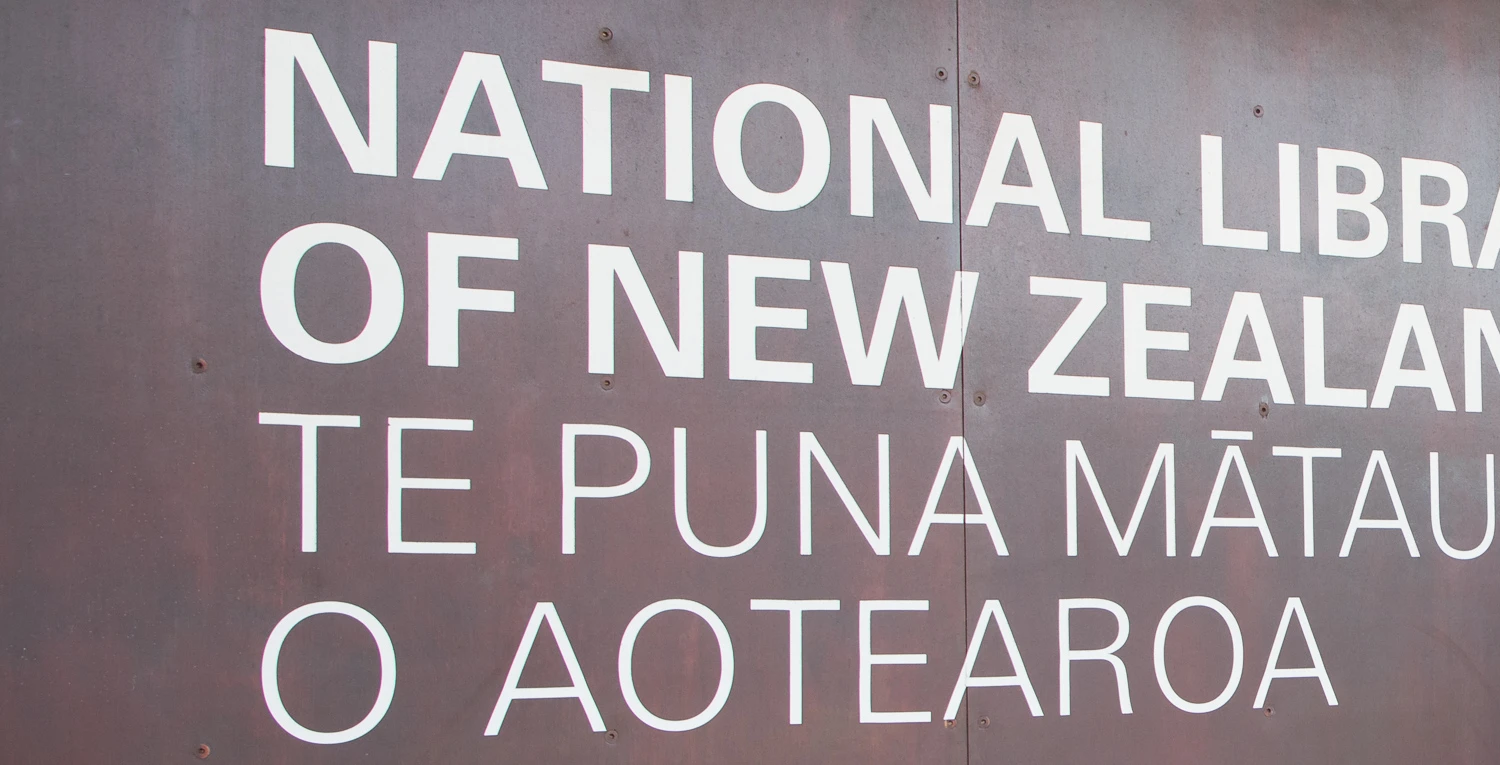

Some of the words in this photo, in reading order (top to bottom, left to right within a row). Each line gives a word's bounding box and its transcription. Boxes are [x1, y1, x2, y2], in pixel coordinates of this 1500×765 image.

[265, 28, 1151, 242] NATIONAL
[260, 222, 519, 368] OF
[588, 243, 980, 390] NEW
[259, 412, 477, 555] TE
[562, 423, 1010, 558] PUNA
[261, 601, 397, 745] O
[484, 597, 1339, 736] AOTEAROA
